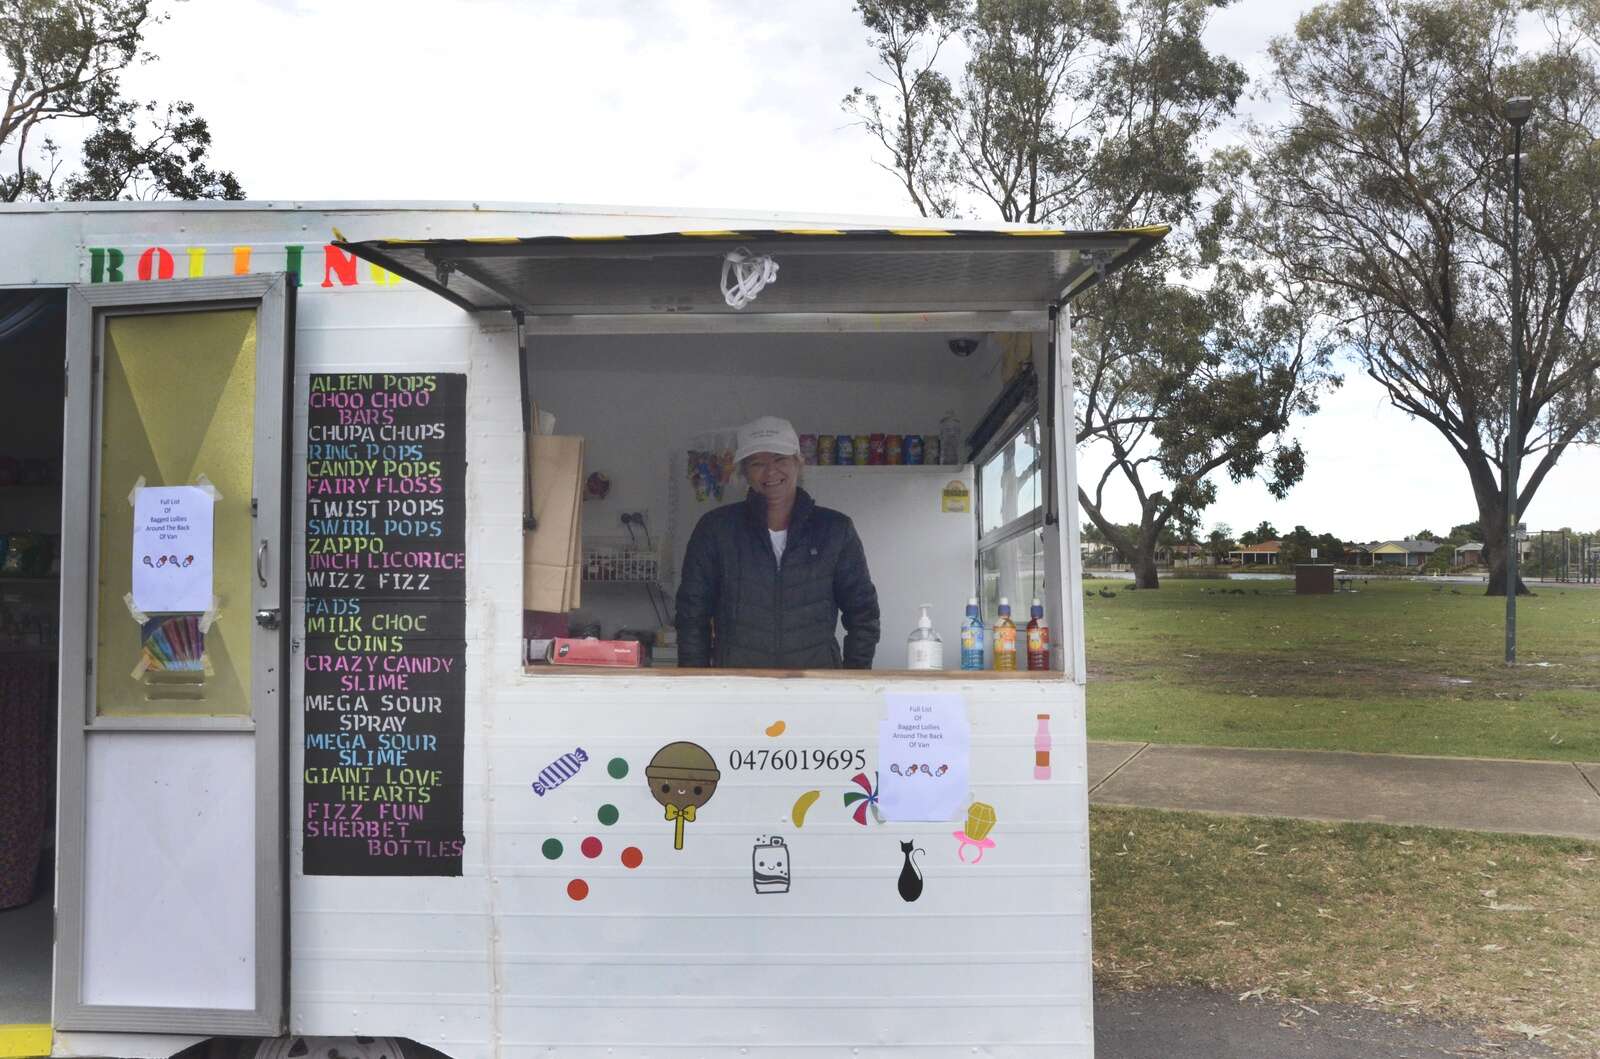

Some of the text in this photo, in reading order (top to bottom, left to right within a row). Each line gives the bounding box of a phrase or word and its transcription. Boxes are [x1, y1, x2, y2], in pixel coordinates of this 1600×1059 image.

[312, 375, 436, 392] ALIEN POPS
[310, 391, 429, 408] CHOO CHOO
[339, 409, 394, 424] BARS
[309, 424, 445, 442] CHUPA CHUPS
[309, 444, 422, 460] RING POPS
[308, 461, 440, 477] CANDY POPS
[307, 478, 442, 494] FAIRY FLOSS
[310, 498, 444, 518] TWIST POPS
[308, 520, 442, 537] SWIRL POPS
[309, 538, 383, 554] ZAPPO
[368, 552, 465, 570] LICORICE
[307, 572, 430, 590] WIZZ FIZZ
[306, 598, 360, 615] FADS
[309, 614, 426, 633] MILK CHOC
[335, 635, 403, 653] COINS
[305, 655, 453, 673] CRAZY CANDY
[341, 674, 408, 691] SLIME
[306, 695, 442, 713] MEGA SOUR
[339, 715, 406, 732] SPRAY
[306, 734, 436, 751] MEGA SOUR
[339, 749, 407, 767] SLIME
[729, 749, 866, 770] 0476019695
[305, 768, 442, 787] GIANT LOVE
[341, 785, 431, 803] HEARTS
[308, 803, 423, 822] FIZZ FUN
[307, 821, 409, 837] SHERBET
[368, 840, 463, 858] BOTTLES
